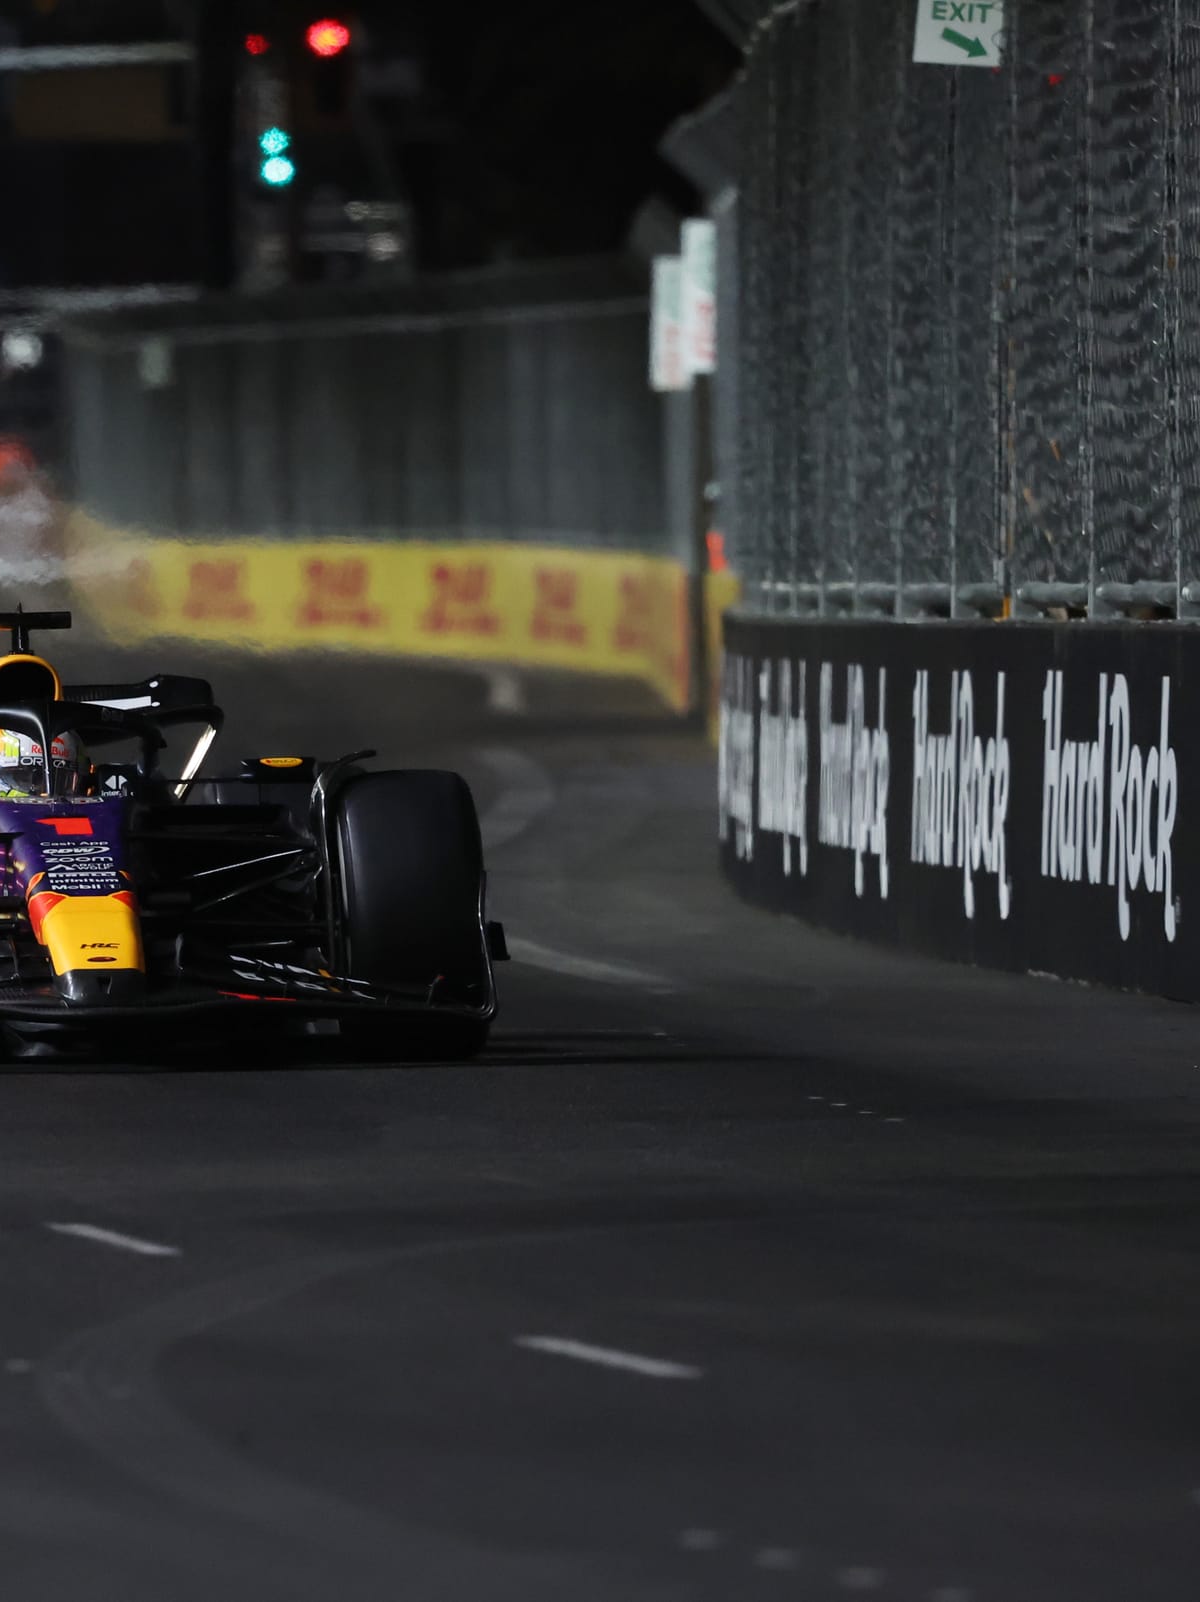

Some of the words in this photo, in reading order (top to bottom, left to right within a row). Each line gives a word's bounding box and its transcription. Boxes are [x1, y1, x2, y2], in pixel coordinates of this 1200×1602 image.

[932, 0, 993, 23] EXIT
[1041, 670, 1107, 885] Hard
[1108, 673, 1177, 942] Rock
[35, 817, 93, 835] 1
